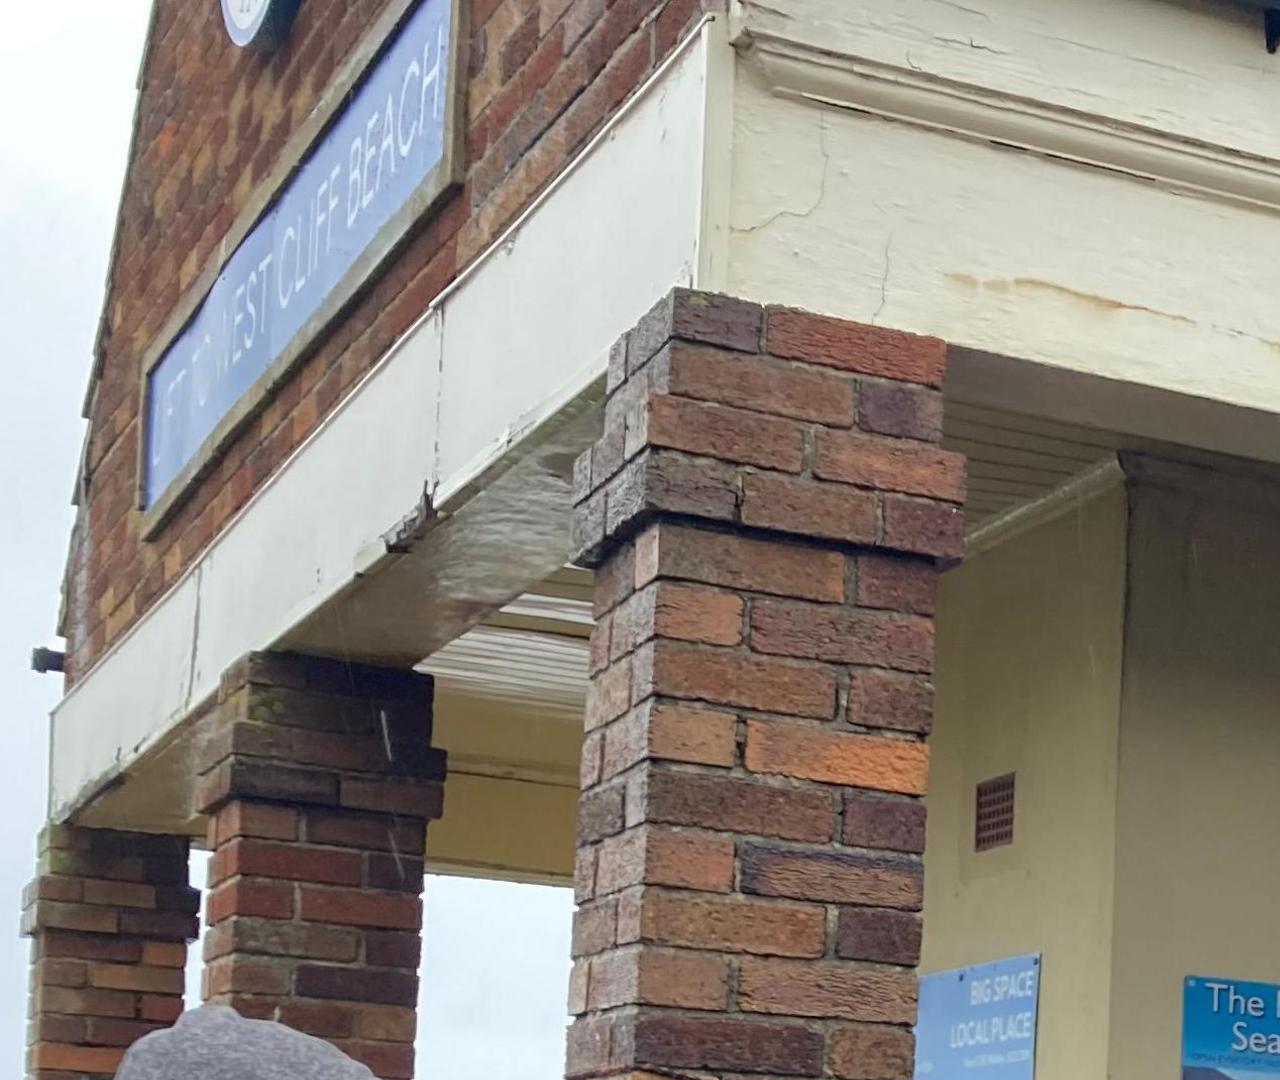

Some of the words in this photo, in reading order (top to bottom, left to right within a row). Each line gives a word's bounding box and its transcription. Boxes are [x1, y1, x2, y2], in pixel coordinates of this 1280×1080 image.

[278, 163, 341, 309] CLIFF
[347, 24, 443, 230] BEACH
[970, 978, 992, 1006] BIG
[993, 969, 1035, 1003] SPACE
[1204, 982, 1265, 1018] The
[950, 1019, 990, 1049] LOCAL
[991, 1011, 1033, 1042] PLACE
